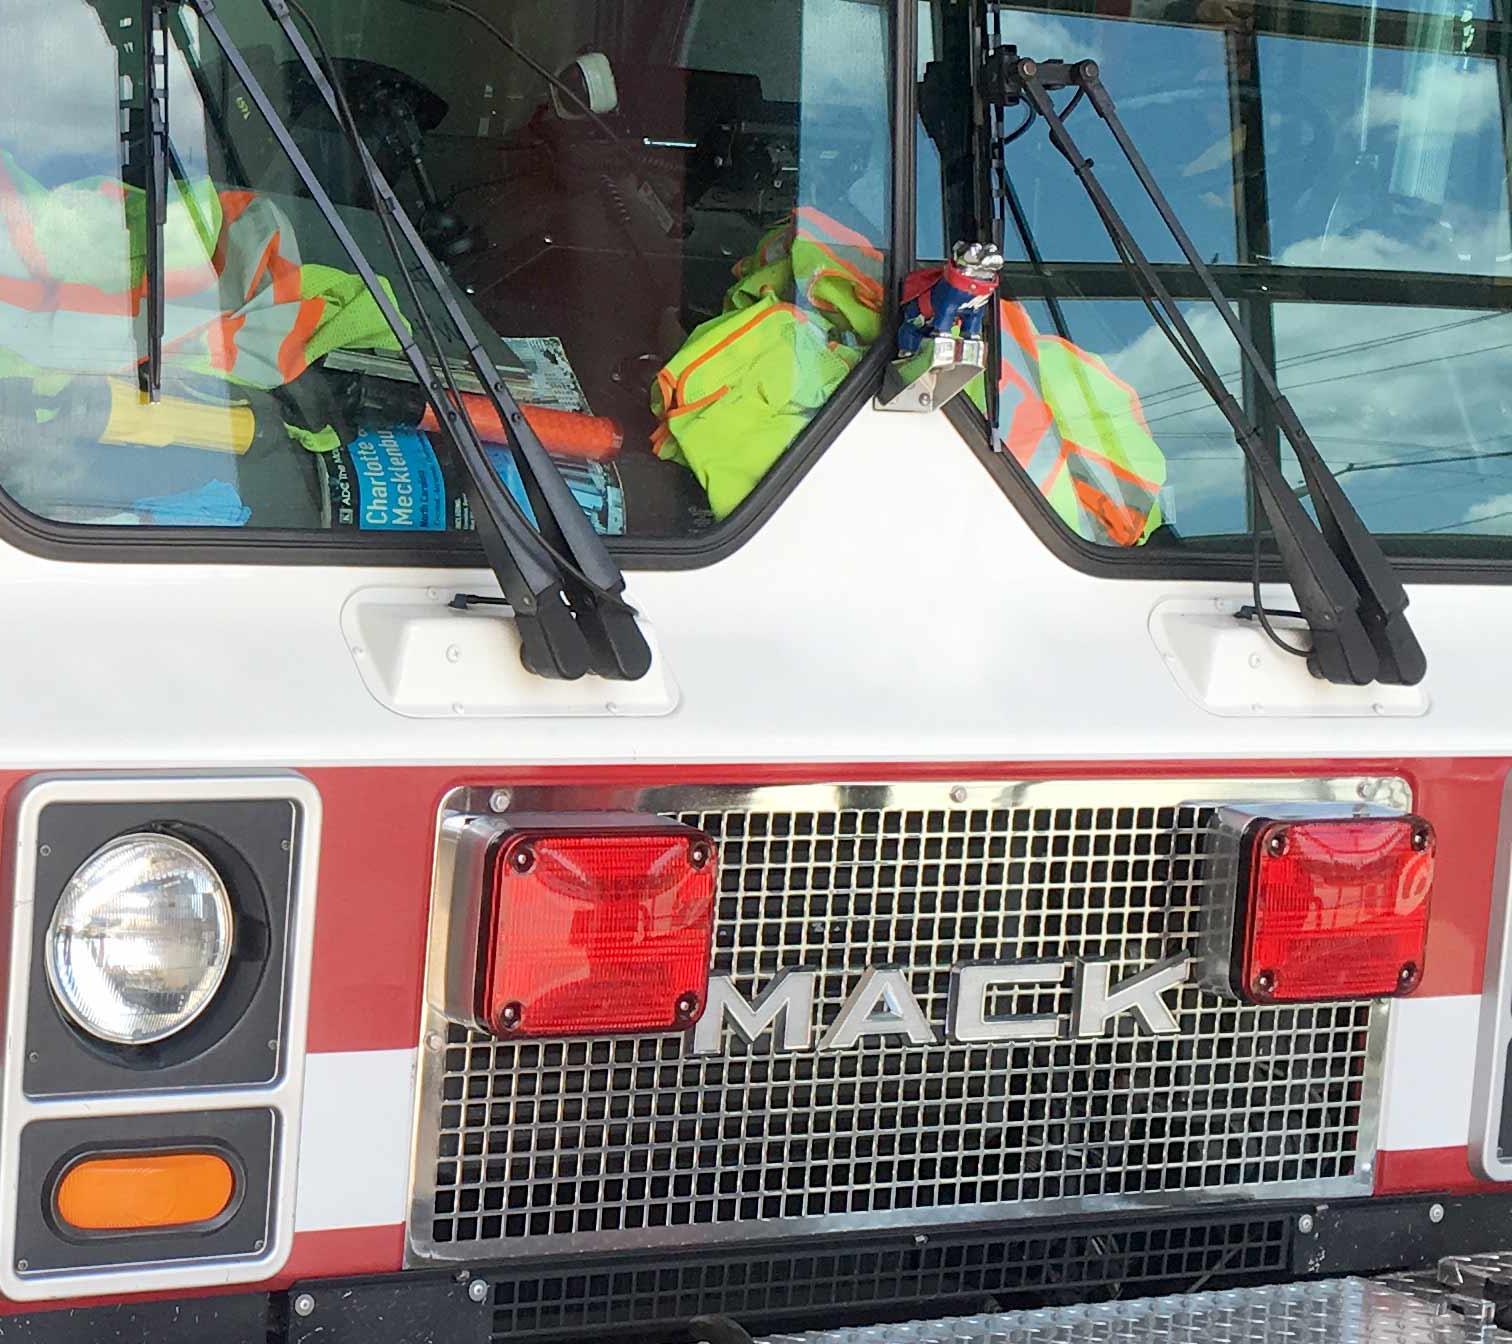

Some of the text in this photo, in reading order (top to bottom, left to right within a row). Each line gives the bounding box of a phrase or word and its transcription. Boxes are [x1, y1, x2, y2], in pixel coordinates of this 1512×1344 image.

[339, 482, 351, 506] ADC
[358, 441, 388, 525] Charlotte
[378, 430, 413, 525] Mecklenbu
[688, 950, 1191, 1055] MACK
